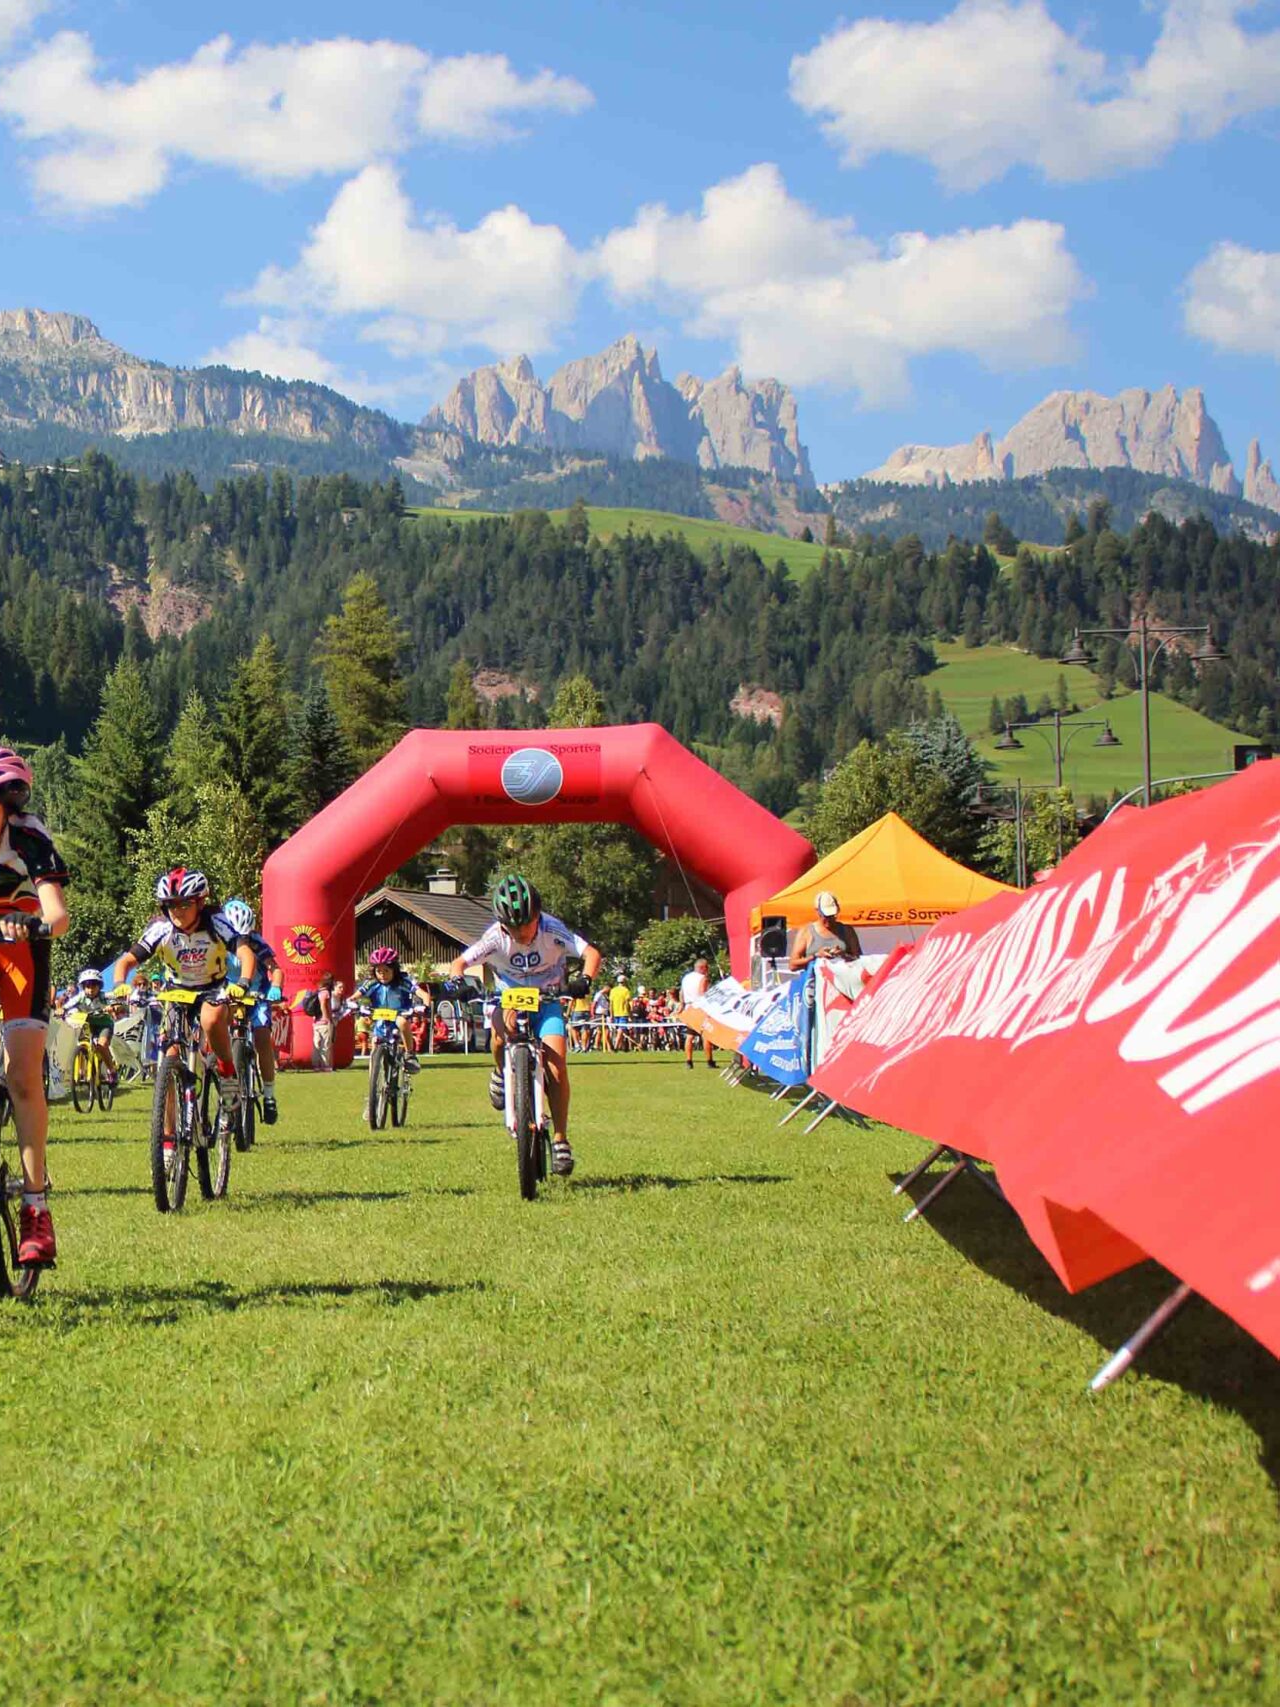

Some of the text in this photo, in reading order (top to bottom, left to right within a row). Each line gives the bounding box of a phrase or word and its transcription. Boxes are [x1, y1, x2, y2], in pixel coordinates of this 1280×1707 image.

[549, 743, 602, 757] Sportiva
[866, 909, 903, 921] Esse
[508, 994, 535, 1005] 153
